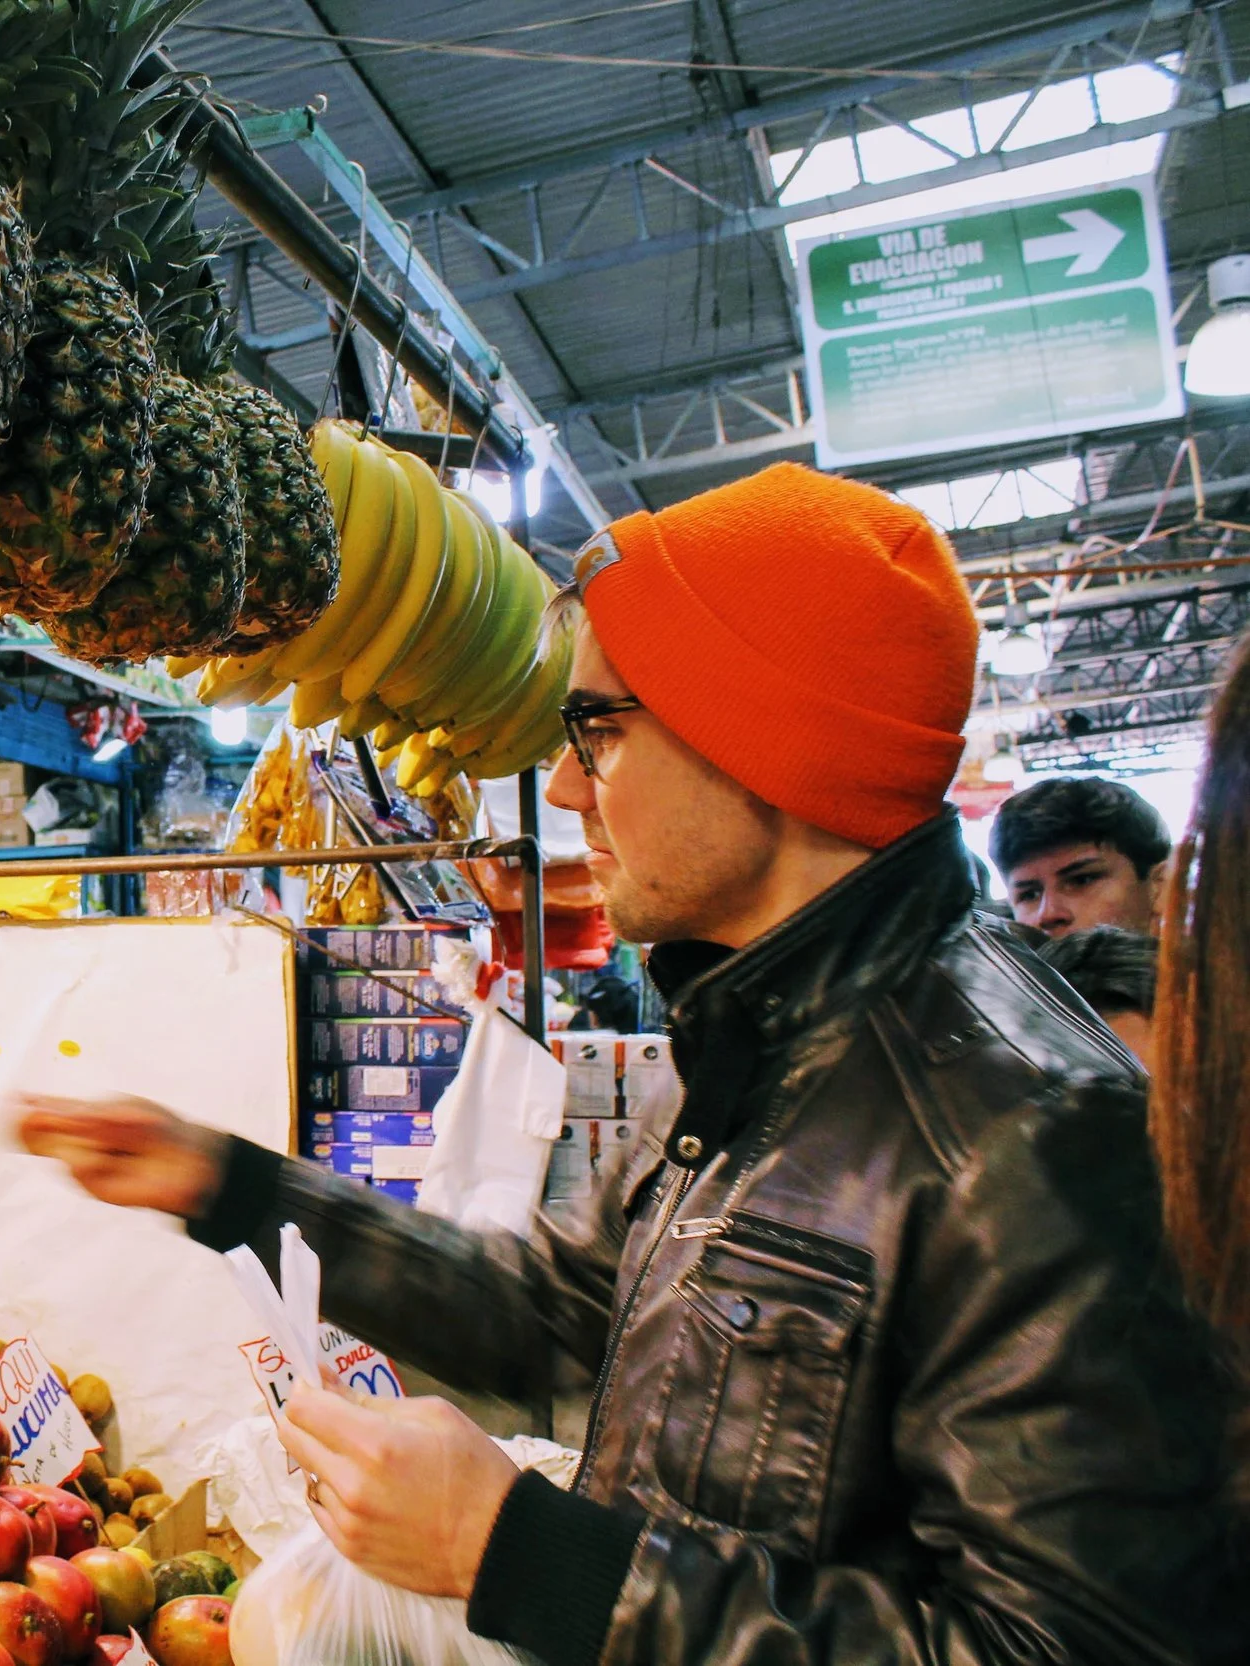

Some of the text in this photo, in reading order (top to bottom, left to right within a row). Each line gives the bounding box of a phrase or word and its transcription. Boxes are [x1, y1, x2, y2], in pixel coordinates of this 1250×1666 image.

[878, 225, 947, 257] VIA DE
[849, 240, 984, 286] EVACUACION
